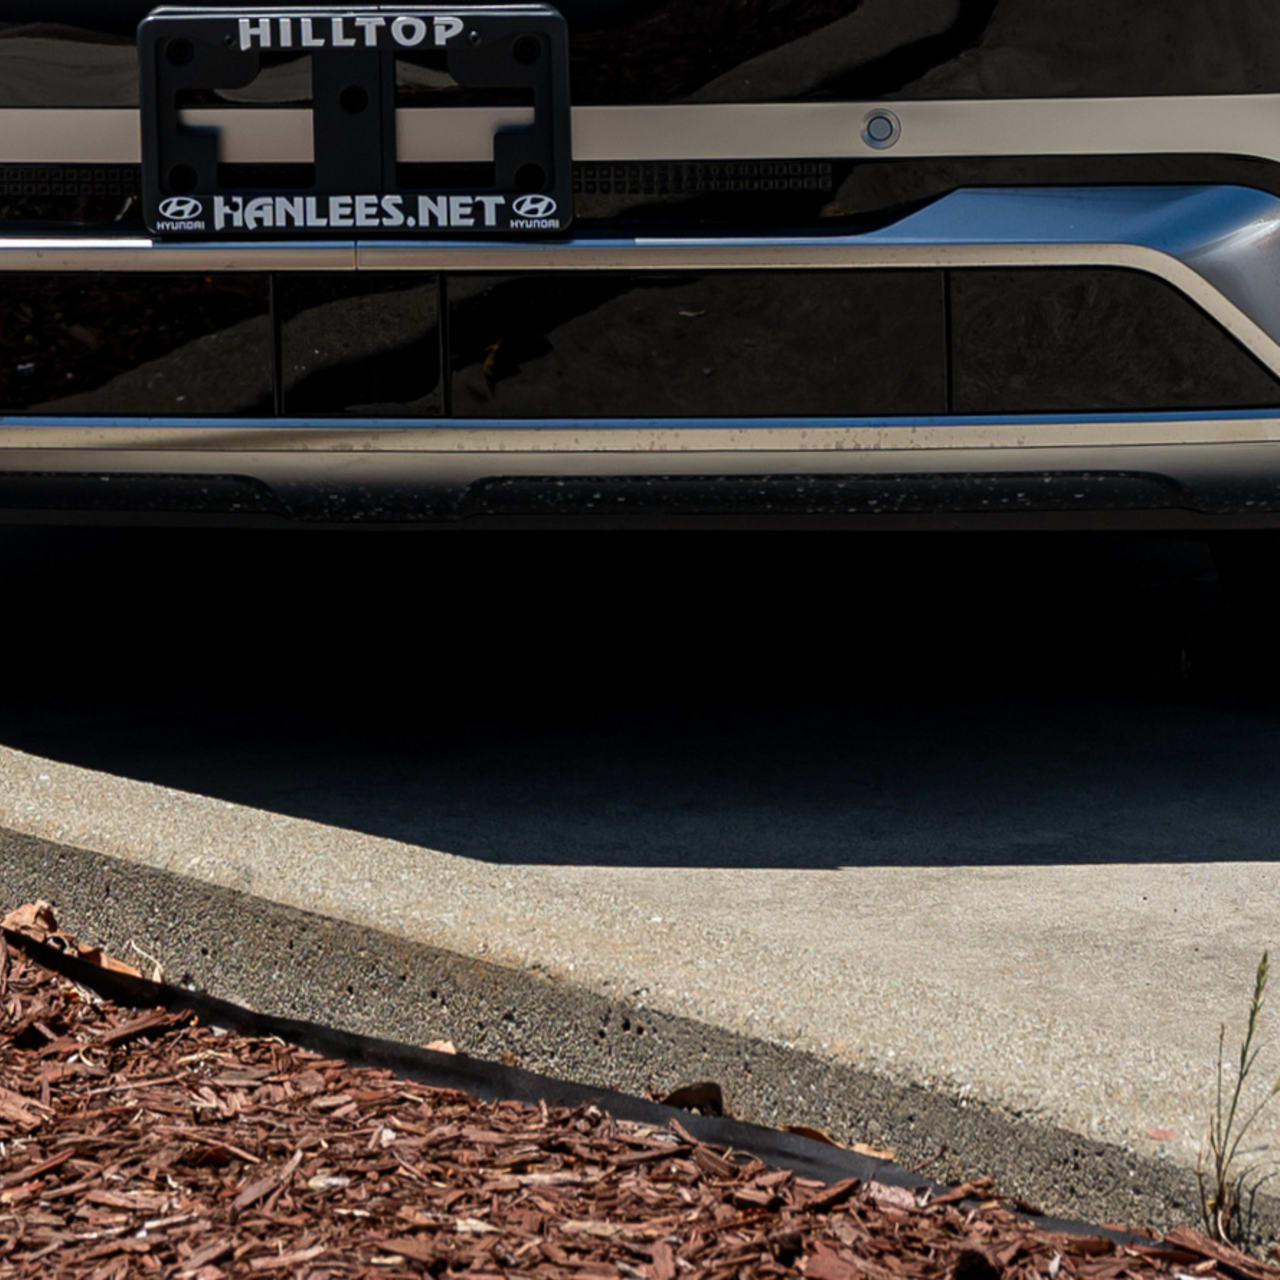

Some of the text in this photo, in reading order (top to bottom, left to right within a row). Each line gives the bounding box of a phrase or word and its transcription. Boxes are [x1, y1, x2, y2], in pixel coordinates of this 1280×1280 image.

[238, 16, 464, 51] HILLTOP
[213, 194, 506, 231] HANLEES.NET
[156, 220, 205, 230] HYUNDAI
[510, 219, 559, 229] HYUNDAI
